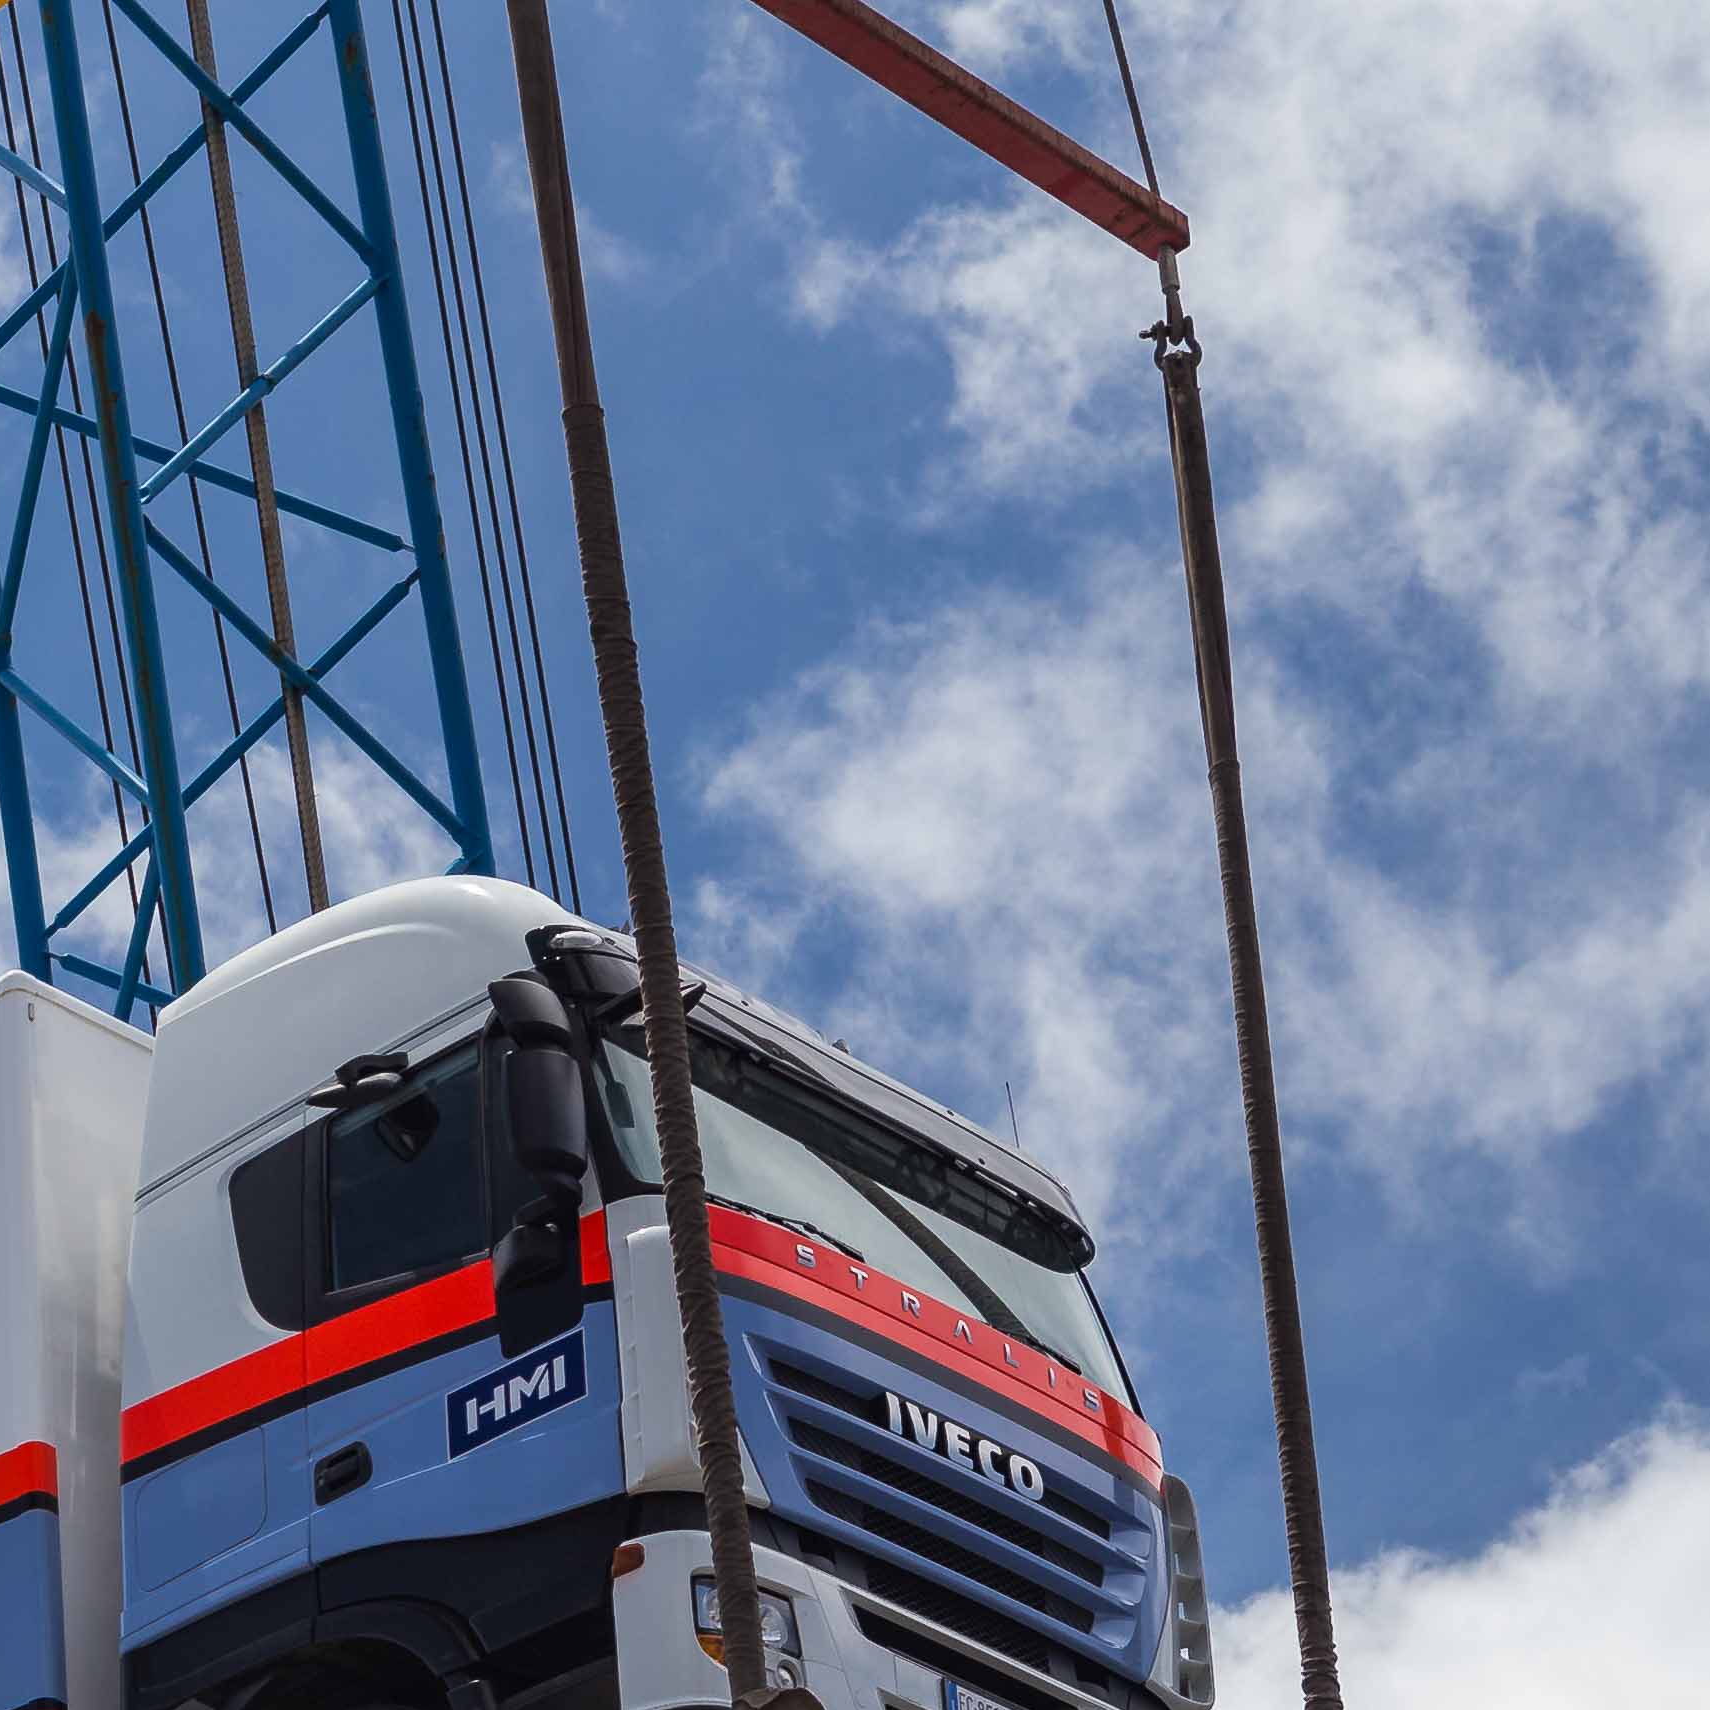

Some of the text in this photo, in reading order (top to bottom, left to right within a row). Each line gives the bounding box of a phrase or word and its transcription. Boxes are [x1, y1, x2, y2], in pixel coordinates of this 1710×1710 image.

[795, 1243, 1102, 1412] STRALIS
[465, 1354, 566, 1435] HMI
[885, 1391, 1044, 1501] IVECO
